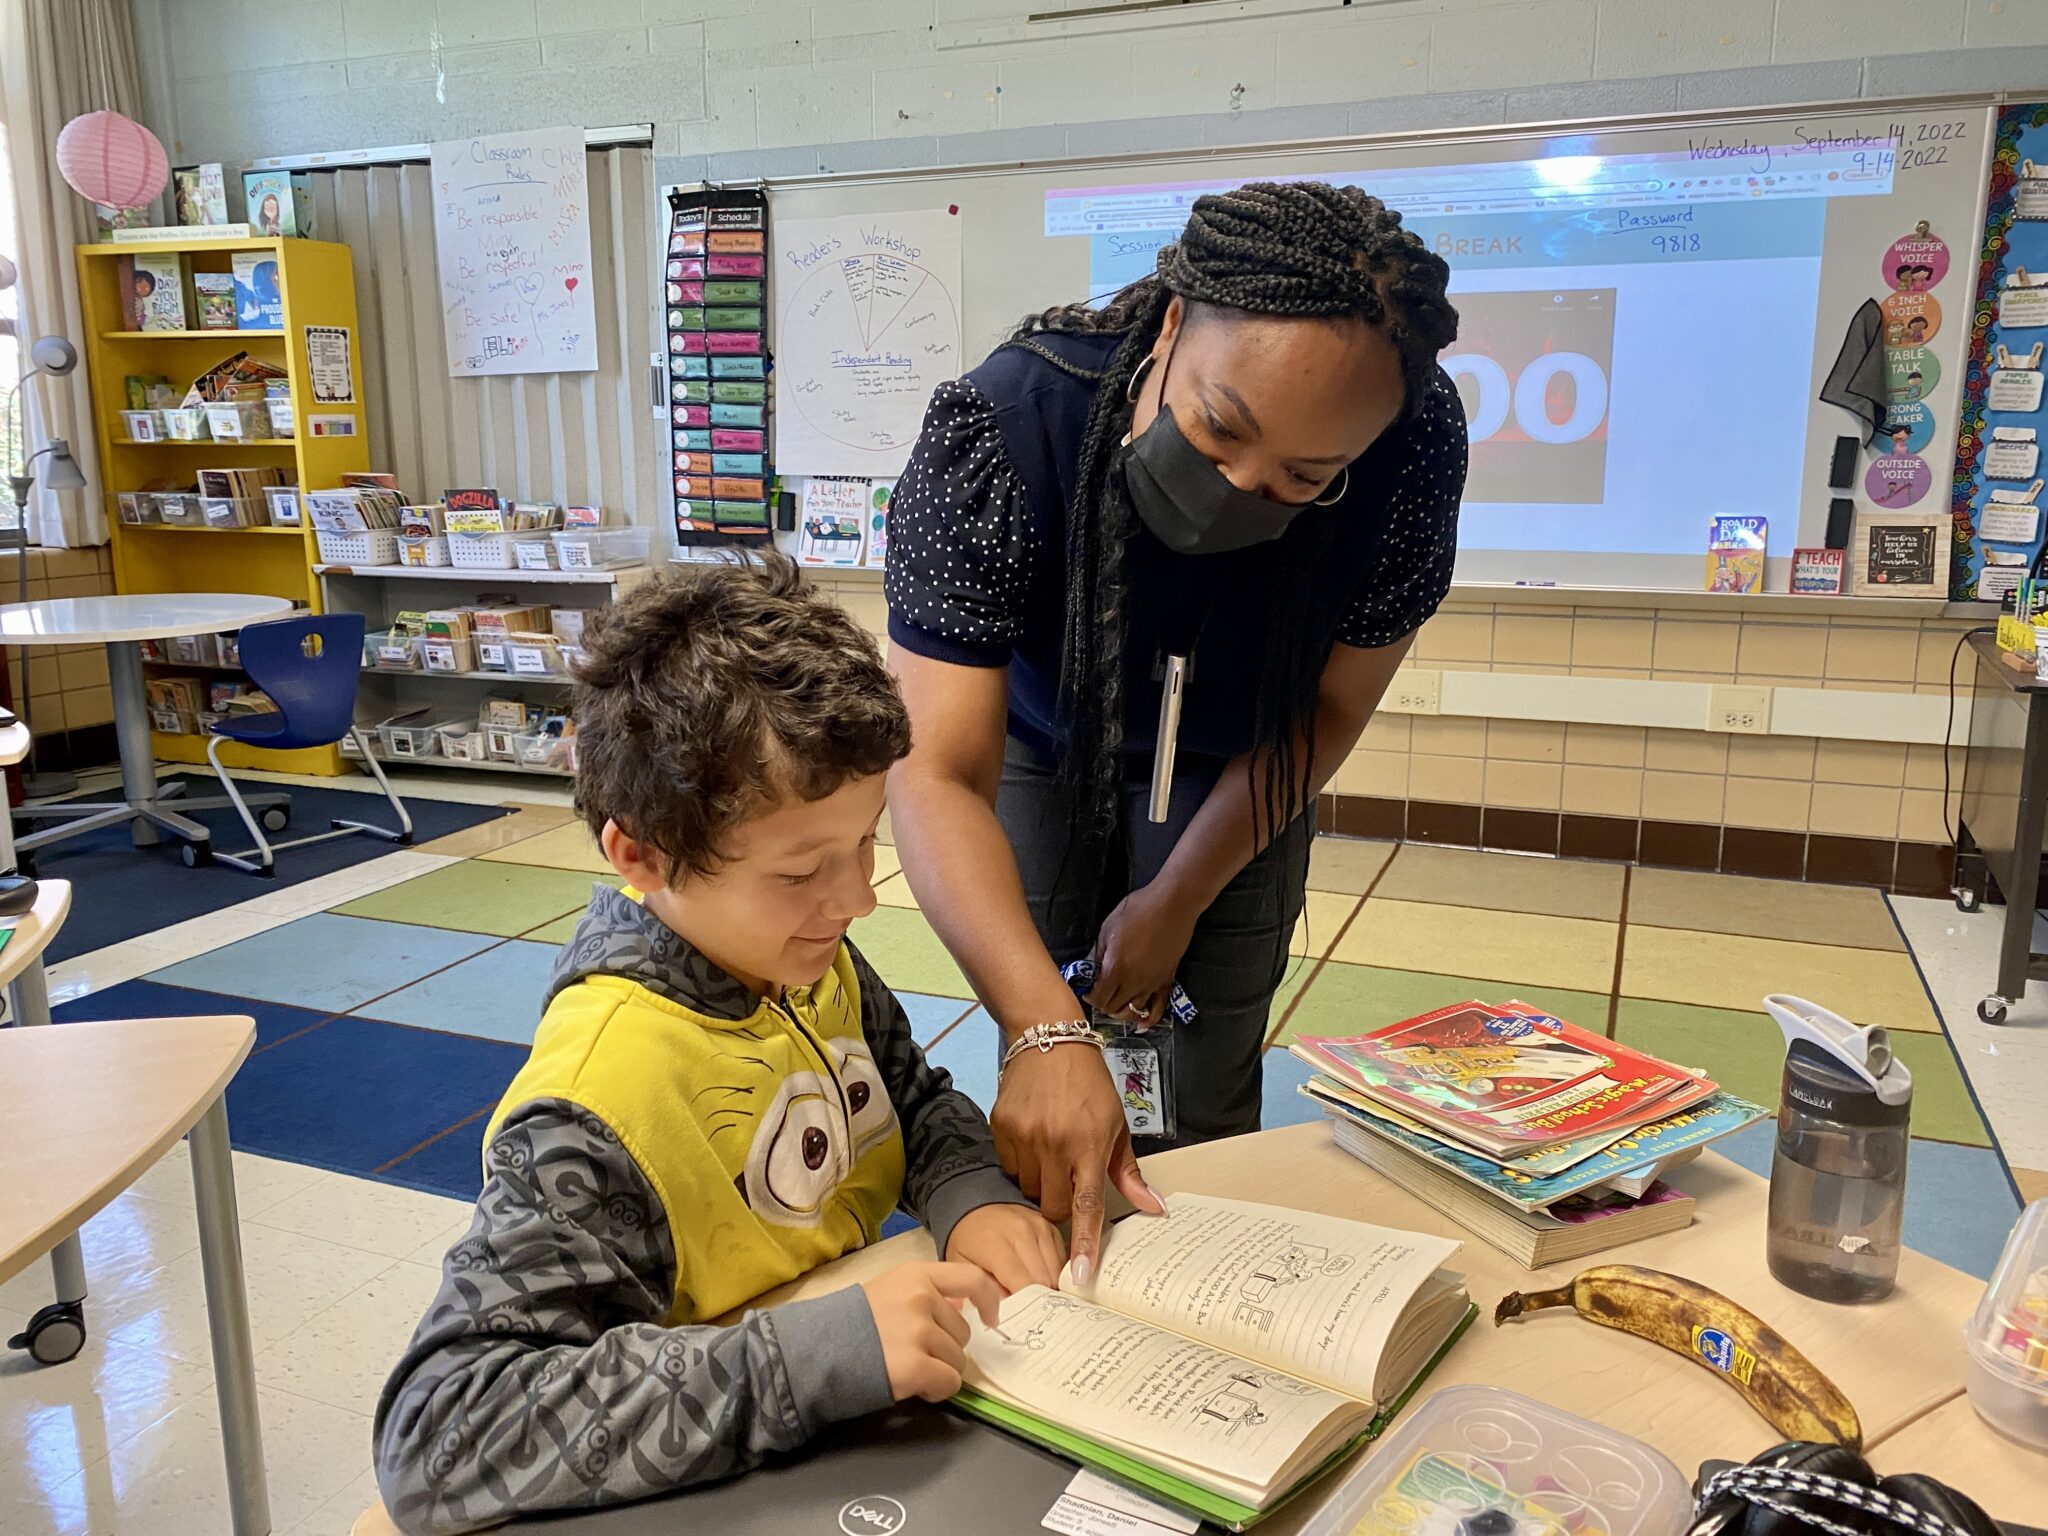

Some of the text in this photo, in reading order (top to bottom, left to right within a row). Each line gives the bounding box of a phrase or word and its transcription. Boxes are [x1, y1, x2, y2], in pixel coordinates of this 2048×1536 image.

[1792, 127, 1886, 156] September
[1917, 122, 1967, 141] 2022
[471, 141, 532, 164] Classroom
[457, 208, 473, 230] Be
[718, 213, 751, 222] Schedule
[1618, 206, 1693, 227] Password
[860, 225, 921, 263] Workshop
[1107, 235, 1161, 255] Session
[1651, 234, 1701, 253] 9818
[1895, 241, 1943, 252] WHISPER
[1900, 253, 1935, 263] VOICE
[459, 257, 476, 279] Be
[1888, 294, 1927, 306] 6 INCH
[464, 308, 481, 327] Be
[1890, 305, 1925, 316] VOICE
[832, 350, 881, 366] Independent
[1888, 348, 1925, 362] TABLE
[1891, 362, 1921, 375] TALK
[1877, 459, 1922, 468] OUTSIDE
[1882, 470, 1915, 479] VOICE
[811, 483, 855, 497] A Letter
[449, 491, 495, 510] DOGZILLA
[1721, 519, 1758, 529] ROALD
[1794, 552, 1840, 565] I TEACH
[1822, 566, 1838, 574] YOUR
[1598, 1077, 1650, 1107] Magic
[1550, 1099, 1609, 1127] School
[1516, 1116, 1555, 1133] Bus
[848, 1505, 895, 1530] DELL
[1107, 1512, 1139, 1527] Daniel
